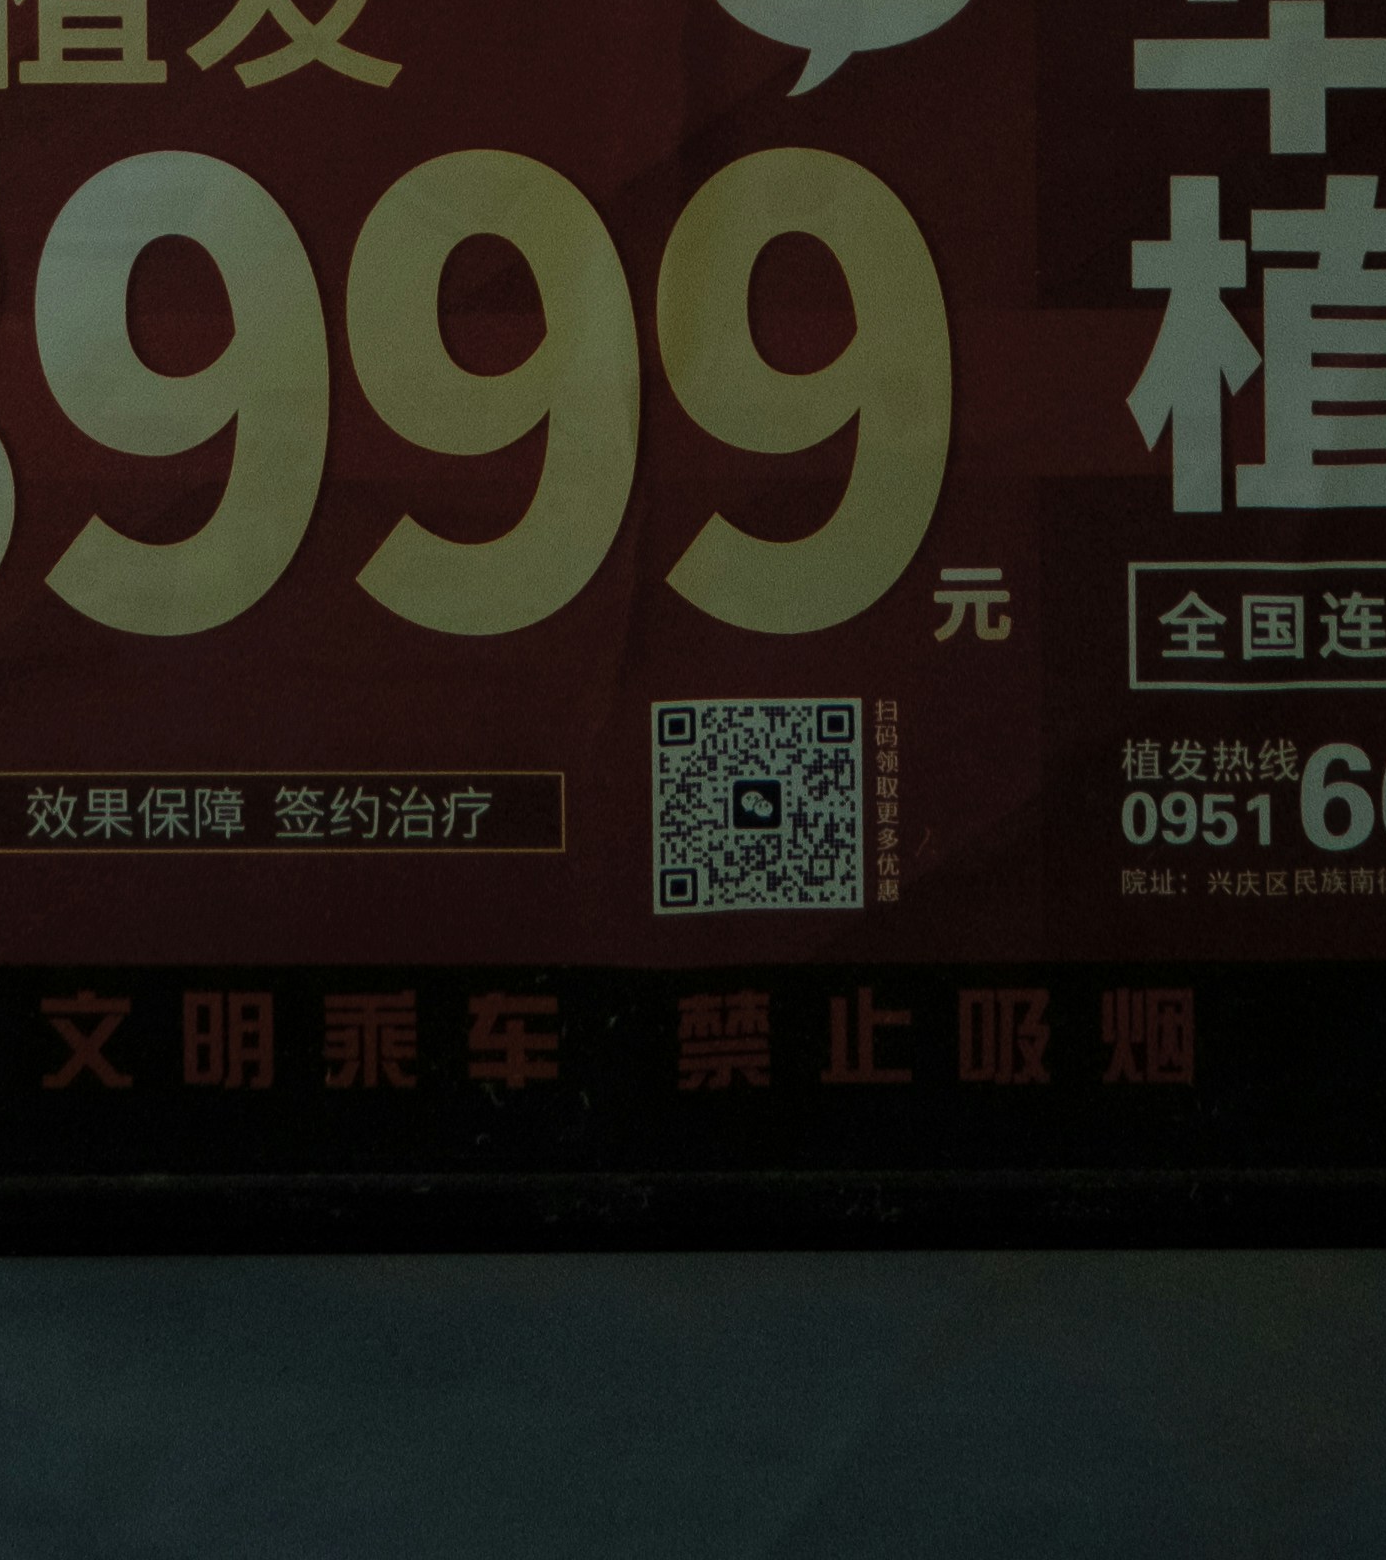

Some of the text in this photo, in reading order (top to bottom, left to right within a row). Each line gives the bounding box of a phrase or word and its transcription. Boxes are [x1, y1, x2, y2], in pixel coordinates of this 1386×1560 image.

[1120, 737, 1300, 783] 植发热线
[25, 784, 494, 840] 效果保障 签约治疗
[874, 698, 900, 904] 扫码领取更多优惠
[1120, 791, 1273, 848] 0951
[38, 985, 1197, 1092] 文明乘车 禁止吸烟
